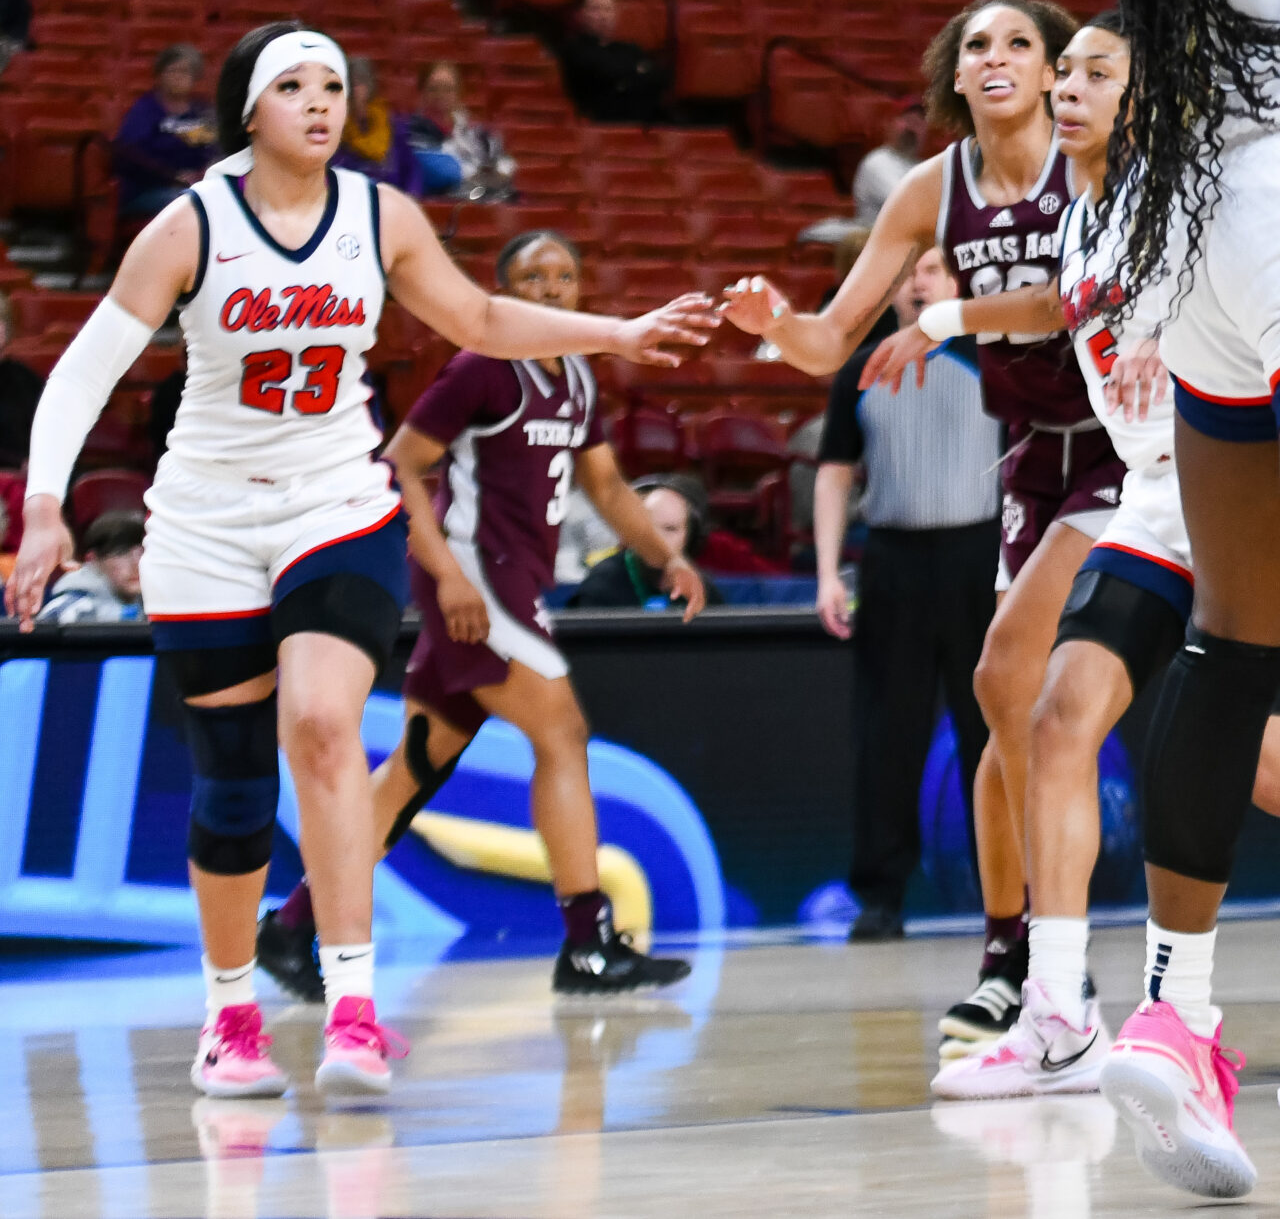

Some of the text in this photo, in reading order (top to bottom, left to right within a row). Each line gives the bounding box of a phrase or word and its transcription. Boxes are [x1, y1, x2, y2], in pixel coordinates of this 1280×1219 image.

[954, 236, 1018, 271] TEXAS
[220, 283, 366, 334] Ole Miss
[240, 344, 347, 416] 23
[546, 449, 572, 526] 3
